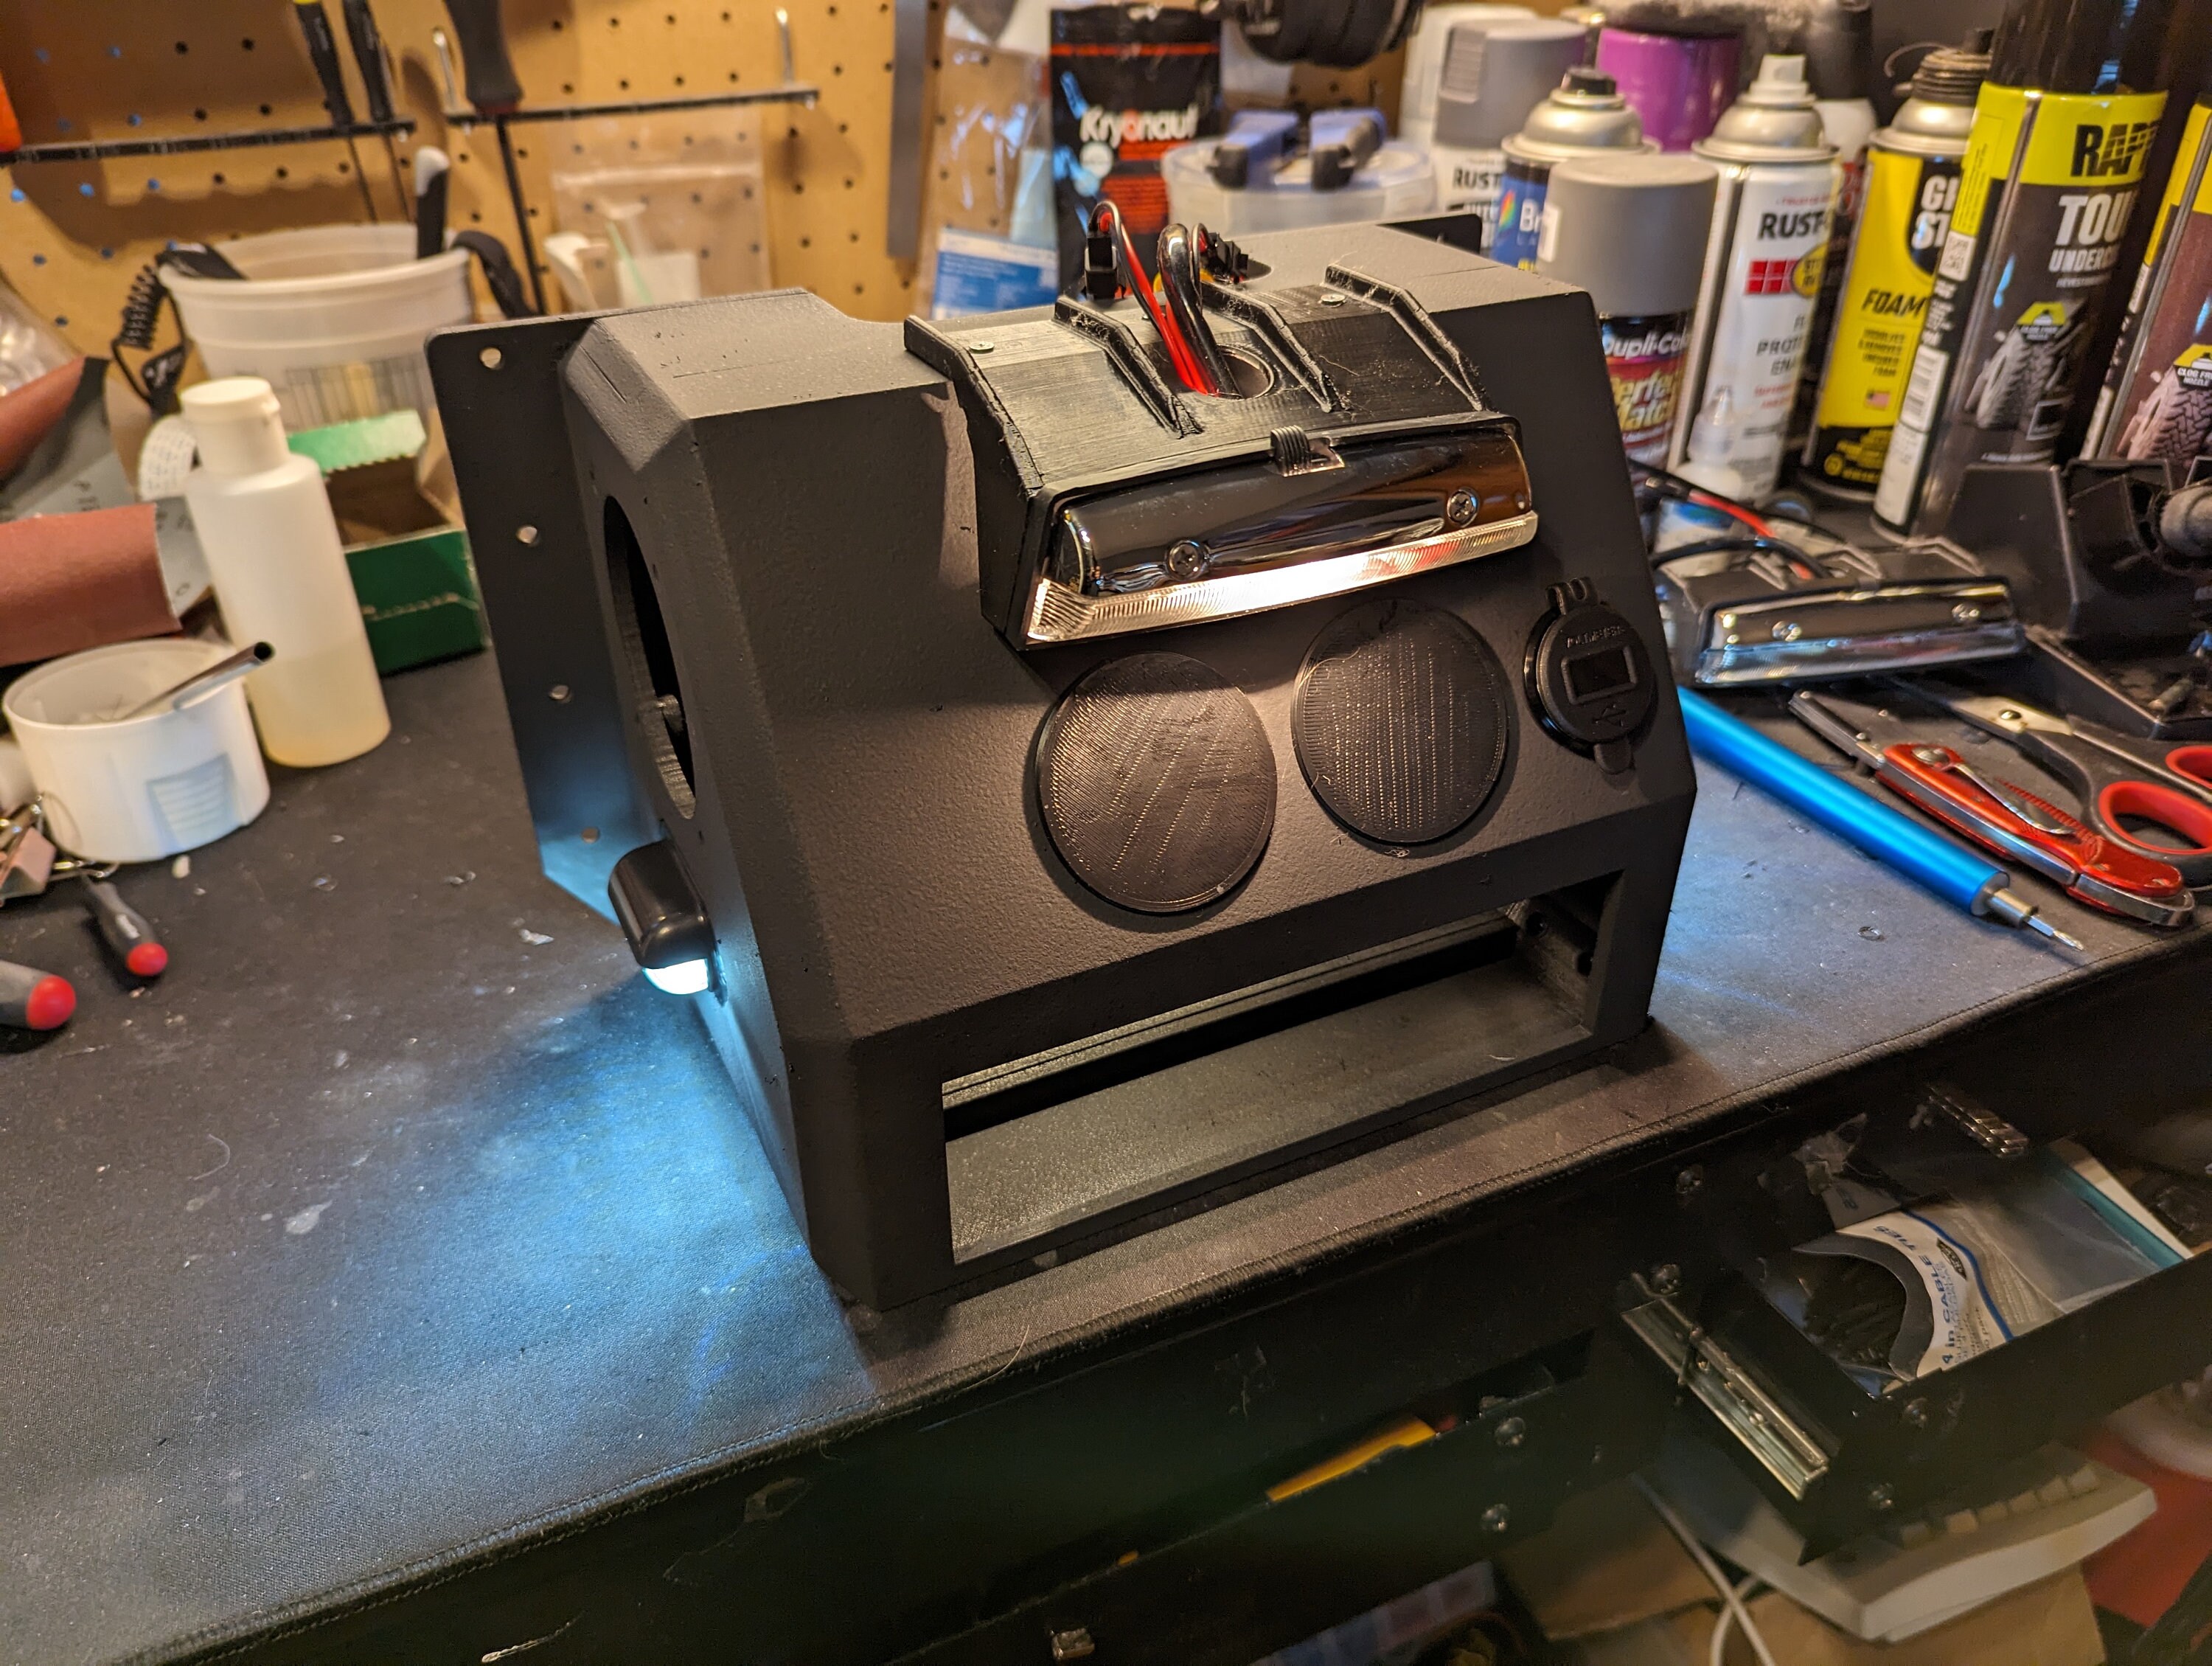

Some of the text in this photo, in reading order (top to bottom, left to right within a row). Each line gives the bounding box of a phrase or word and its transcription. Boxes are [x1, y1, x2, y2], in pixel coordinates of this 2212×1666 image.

[1911, 211, 1951, 249] ST
[2055, 189, 2137, 246] TOU
[1862, 288, 1927, 318] FOAM
[1873, 1226, 1955, 1364] 4 in CABLE TIES
